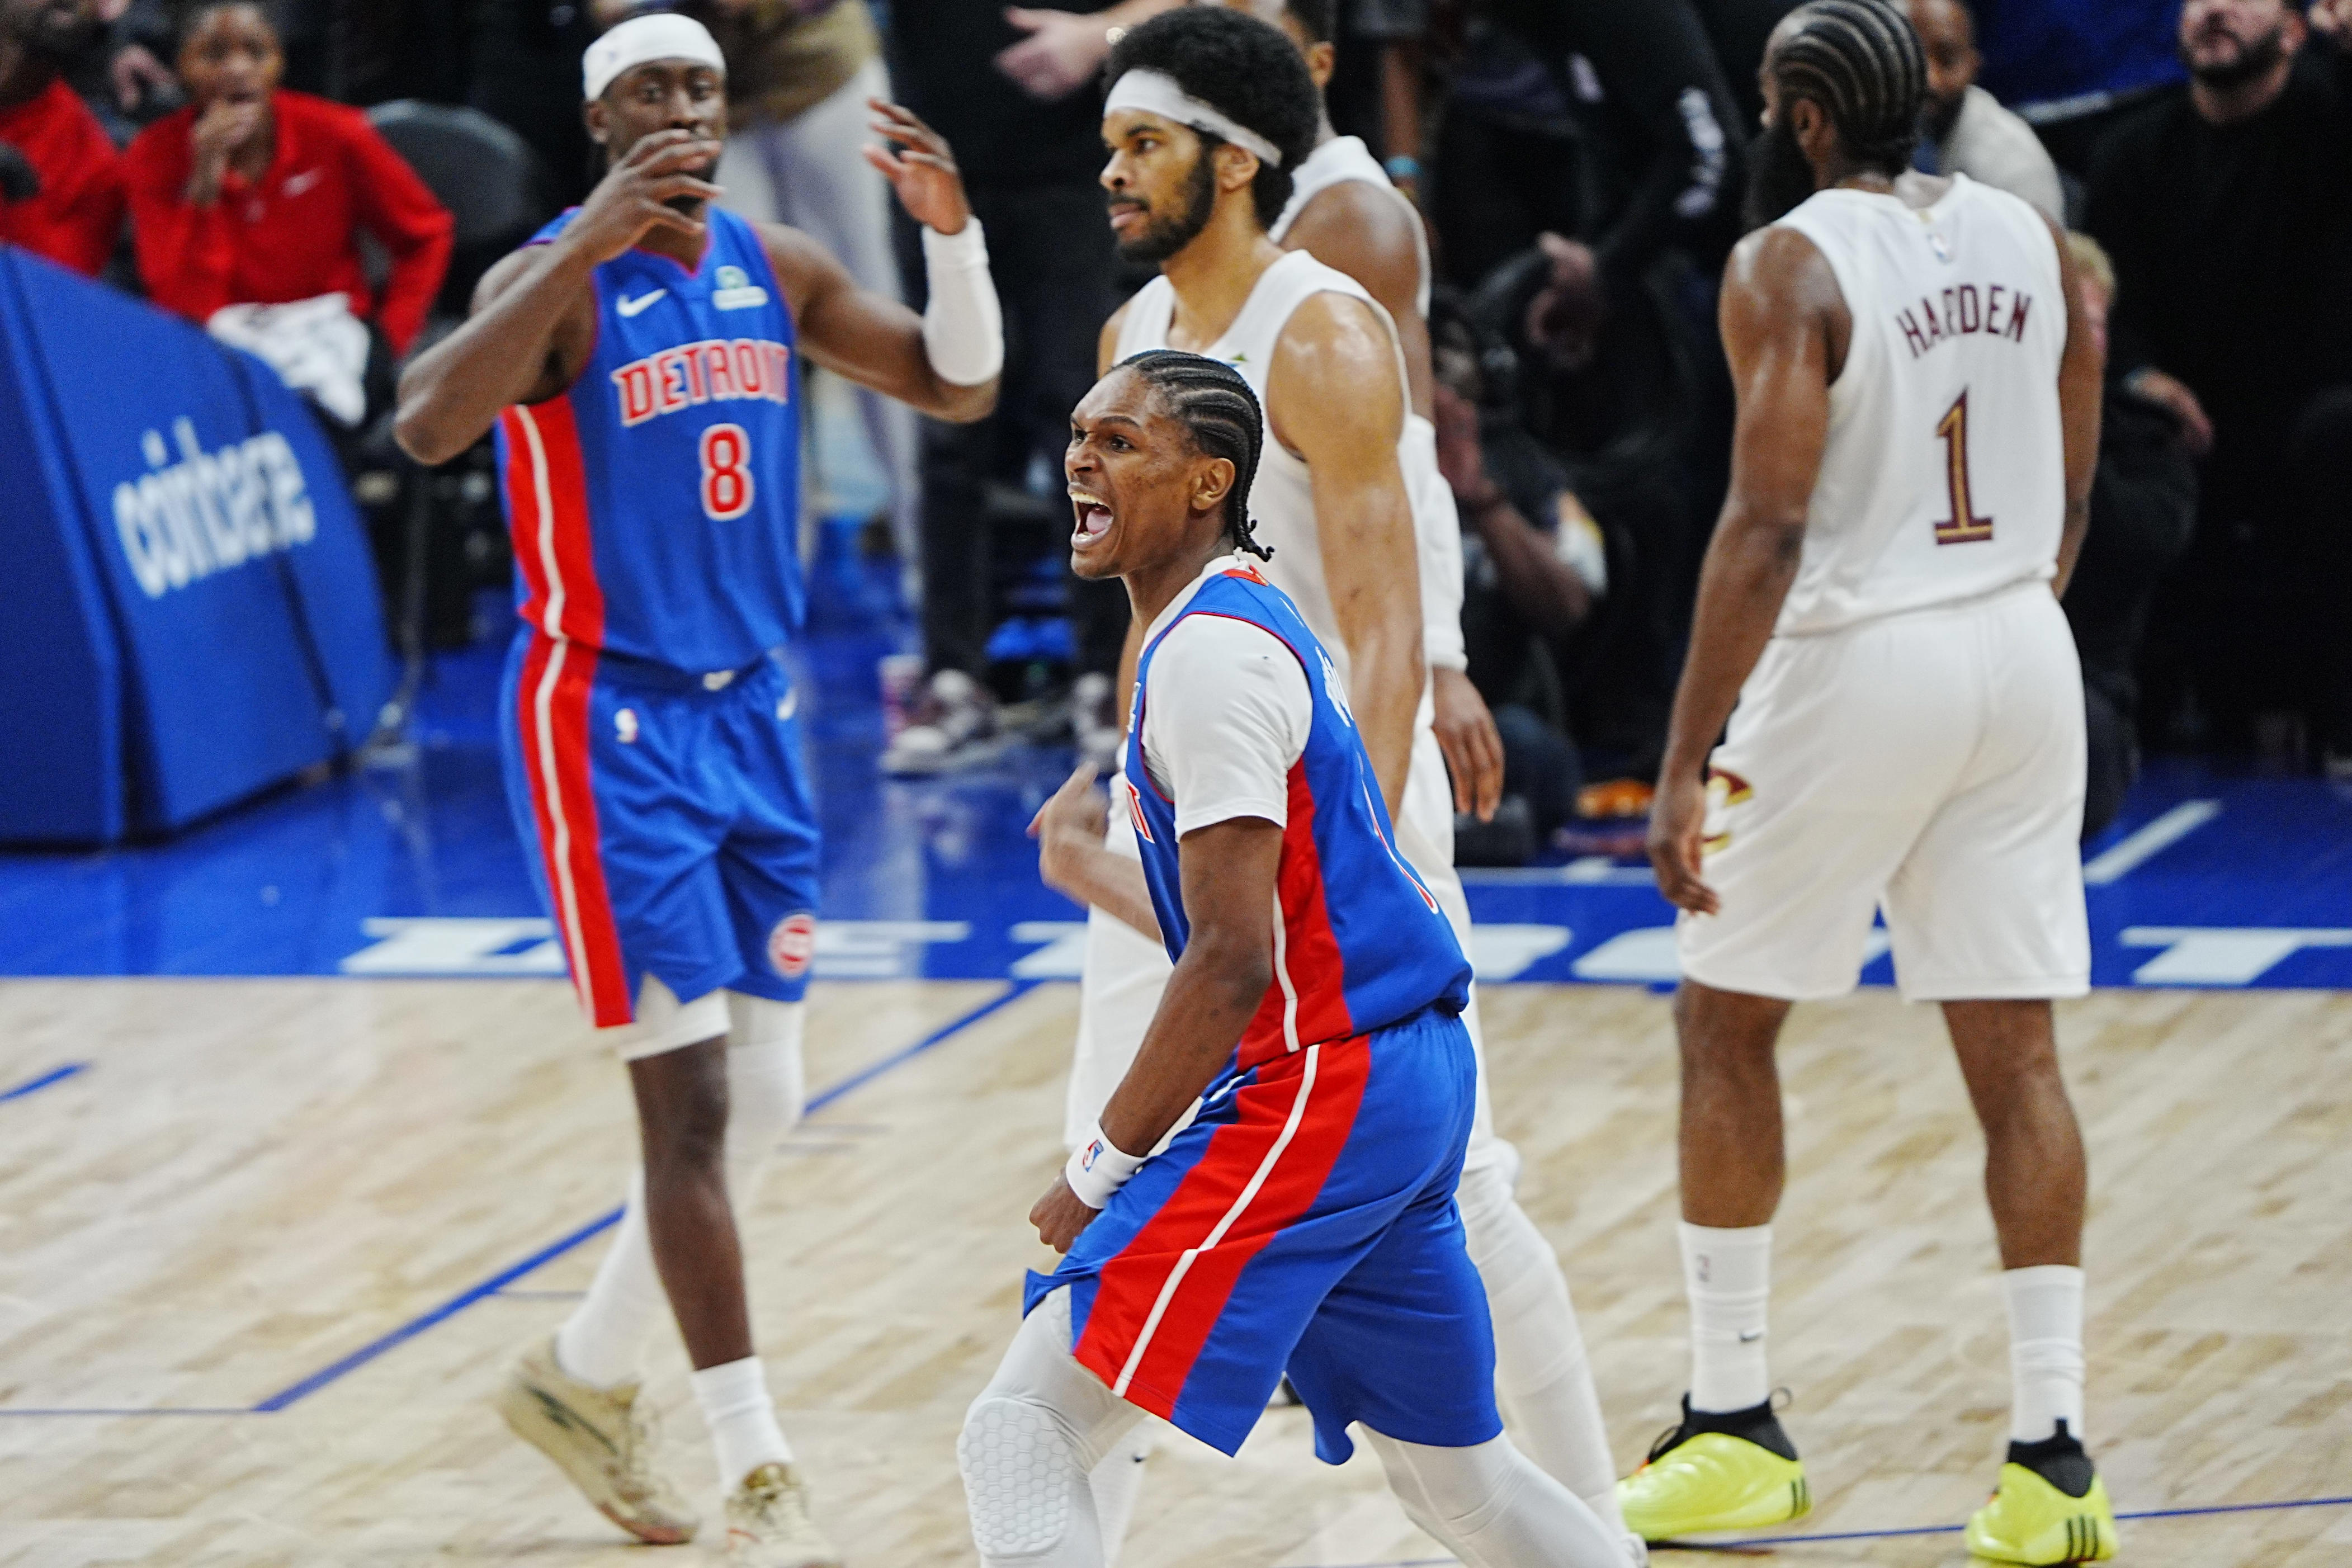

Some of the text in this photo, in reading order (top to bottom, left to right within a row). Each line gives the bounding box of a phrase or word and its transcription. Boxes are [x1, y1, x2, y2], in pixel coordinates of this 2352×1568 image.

[1896, 284, 2033, 358] HARDEN
[611, 338, 788, 428] DETROIT
[699, 423, 754, 522] 8
[1933, 384, 1994, 545] 1
